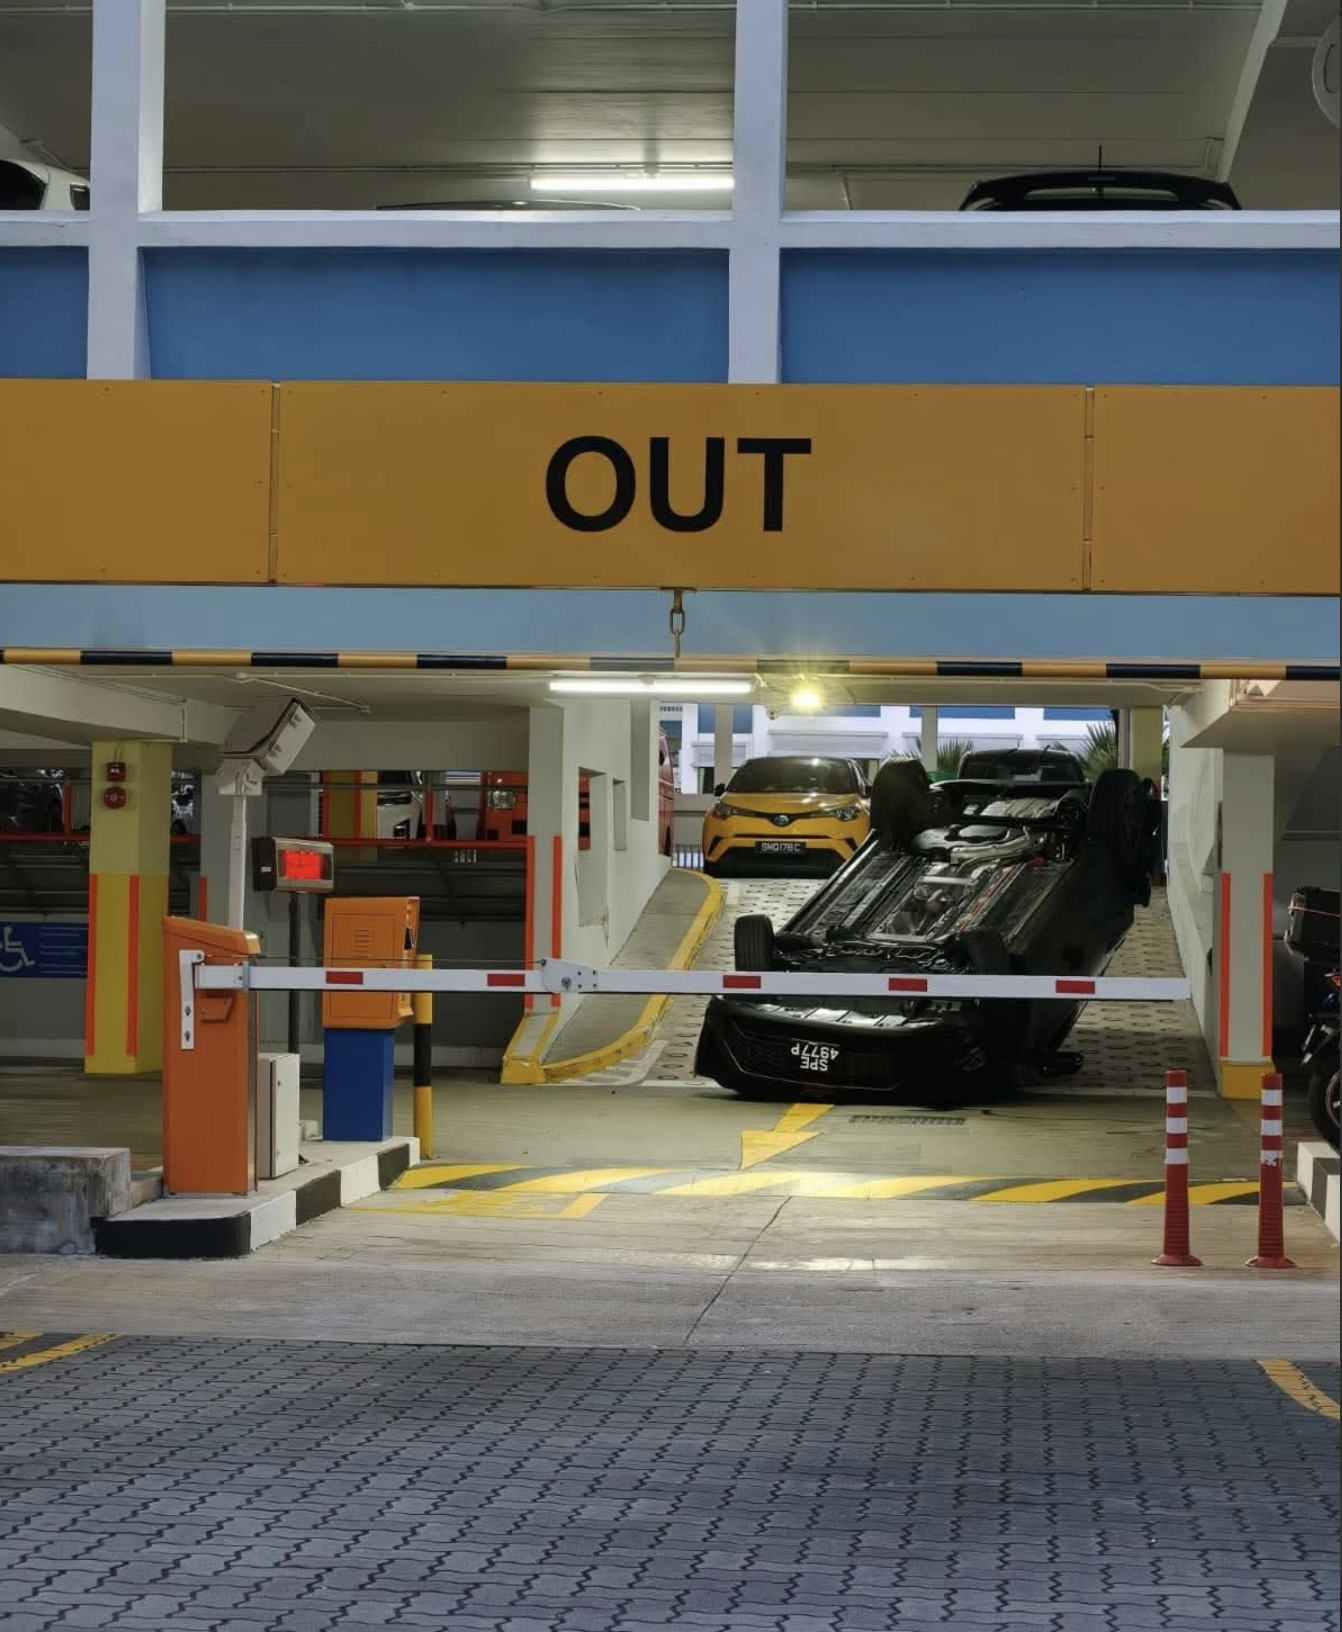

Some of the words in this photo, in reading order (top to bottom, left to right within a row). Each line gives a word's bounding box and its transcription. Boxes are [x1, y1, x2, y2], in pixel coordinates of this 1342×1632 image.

[545, 435, 811, 532] OUT
[791, 1043, 839, 1060] 4977P
[800, 1056, 828, 1071] SPE
